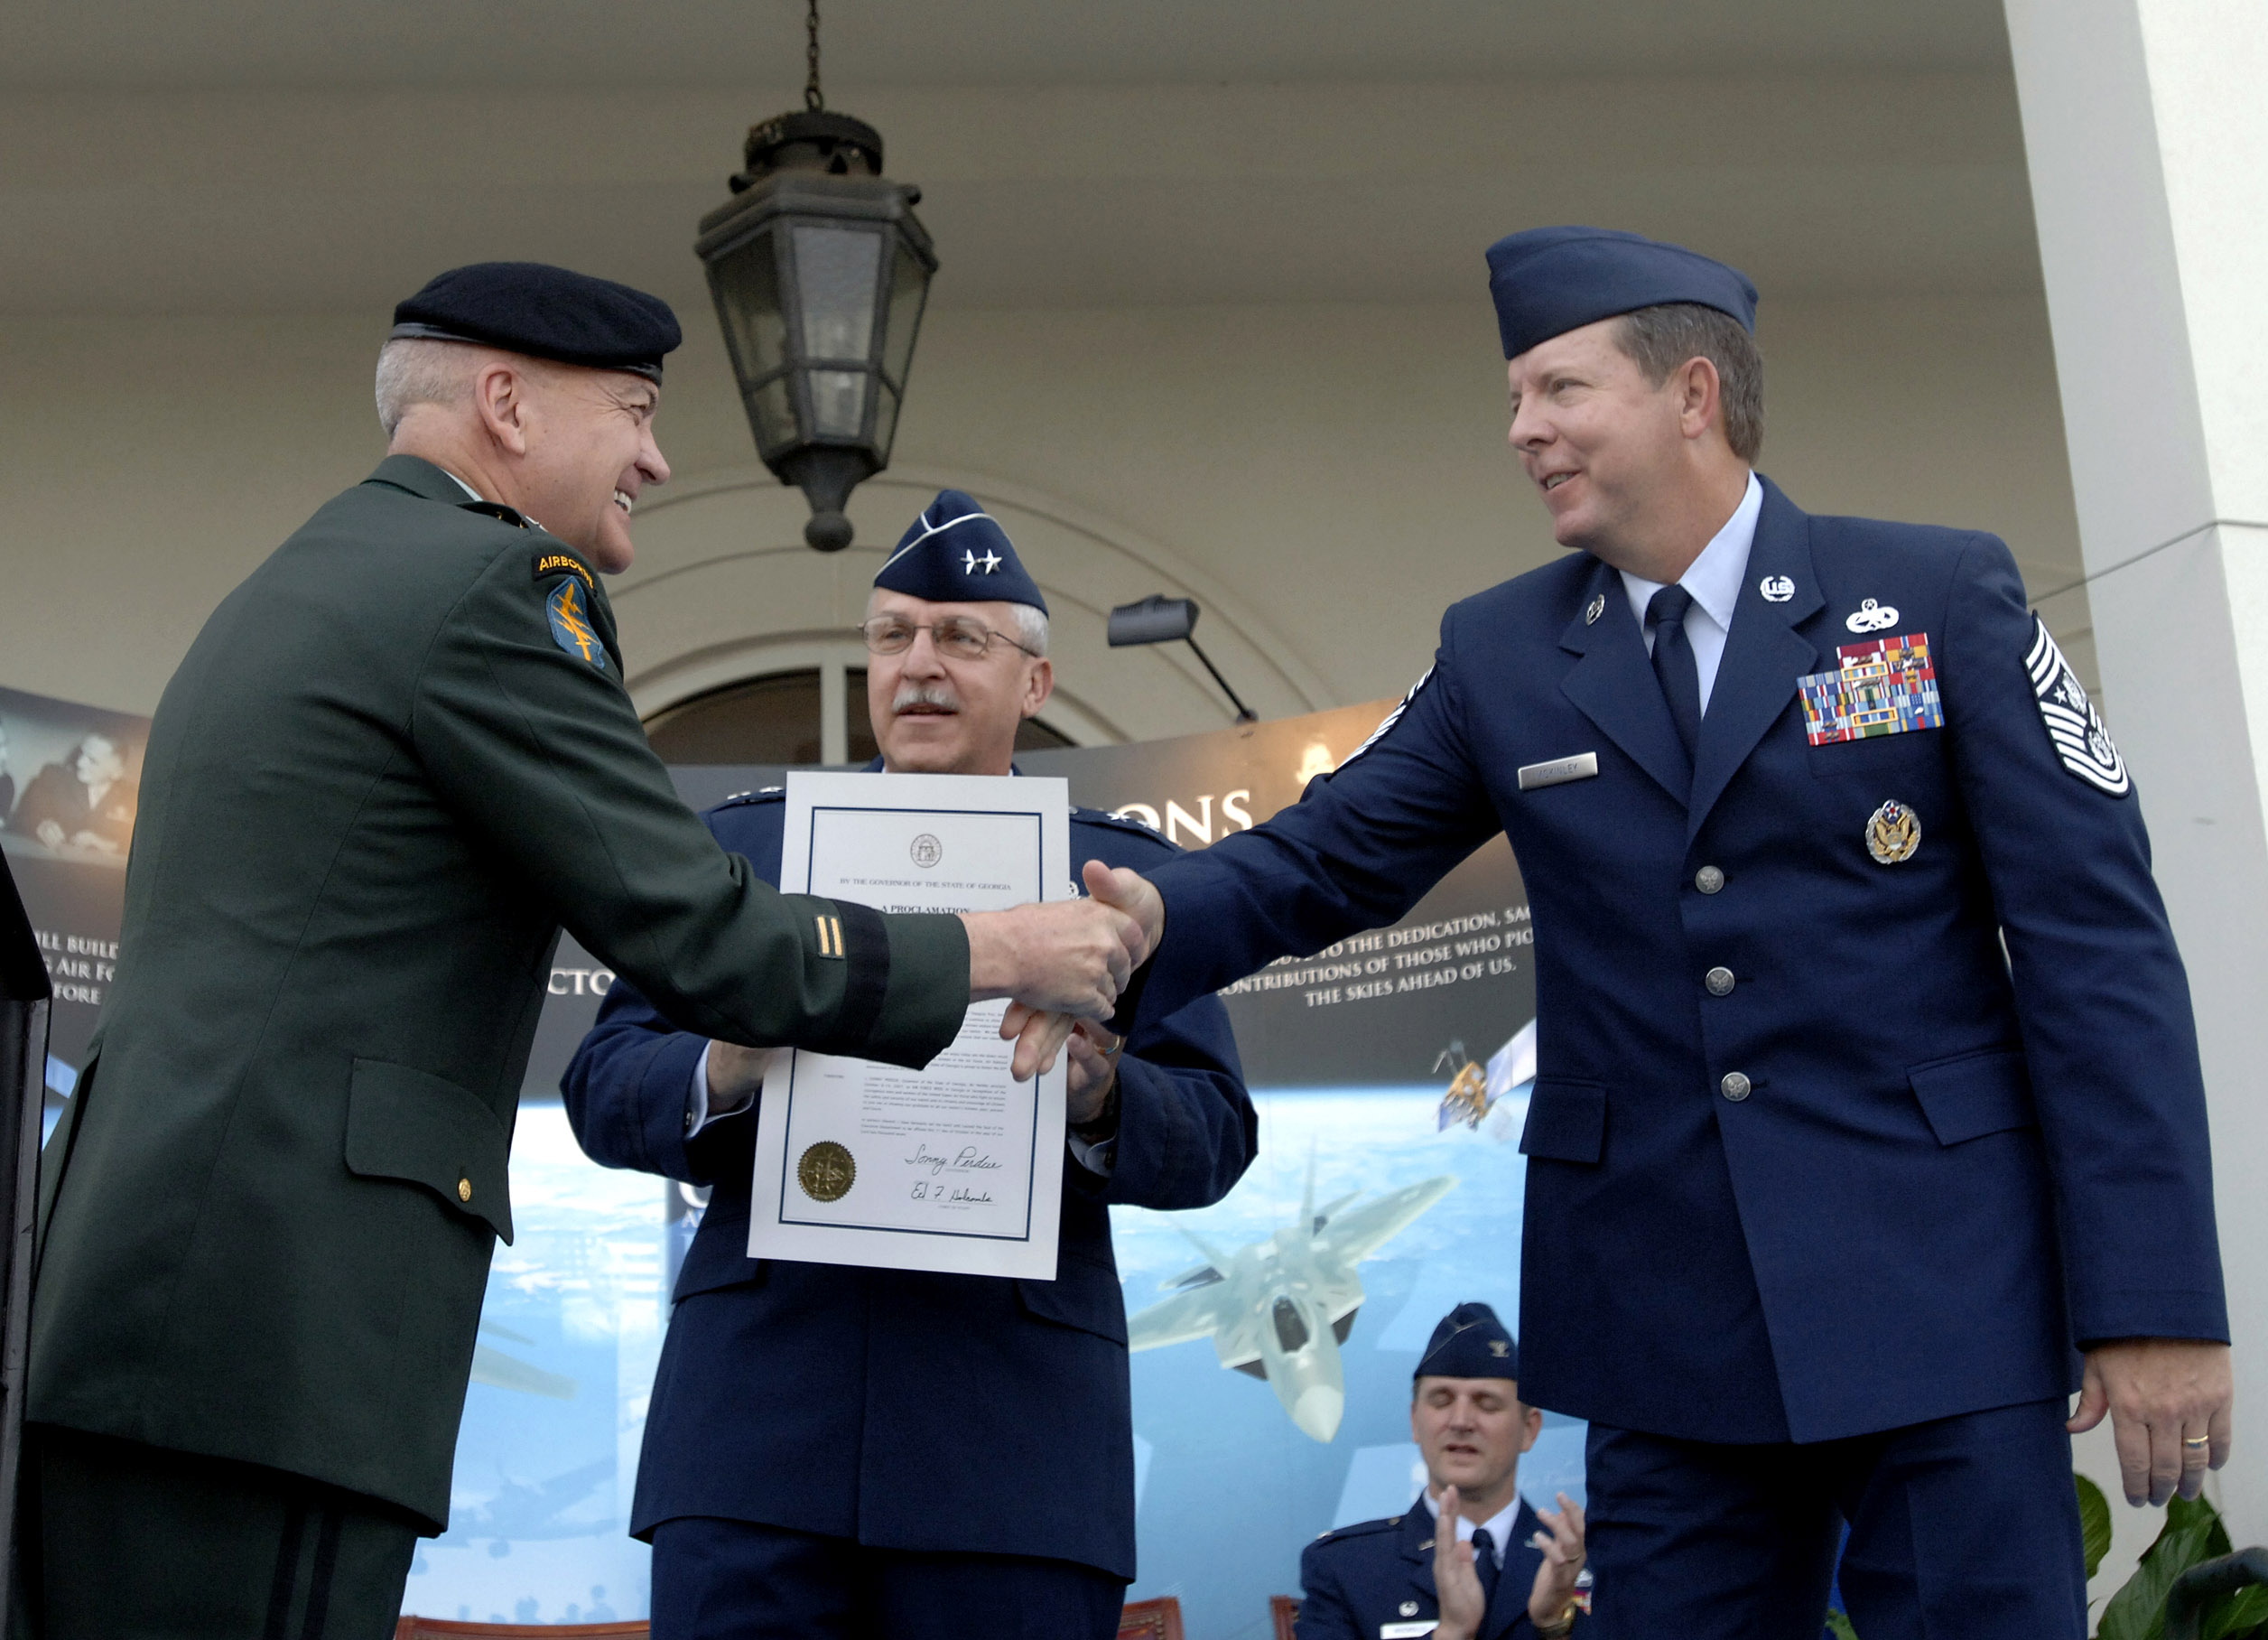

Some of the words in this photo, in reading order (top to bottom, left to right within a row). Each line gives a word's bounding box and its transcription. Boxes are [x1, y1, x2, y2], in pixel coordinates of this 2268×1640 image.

[869, 879, 911, 887] GOVERNOR
[890, 906, 971, 915] PROCLAMATION
[1347, 934, 1384, 955] THE
[1387, 911, 1501, 947] DEDICATION,
[56, 955, 91, 980] AIR
[1217, 961, 1362, 996] ONTRIBUTIONS
[1364, 956, 1390, 974] OF
[1393, 944, 1453, 969] THOSE
[1455, 934, 1501, 957] WHO
[1305, 987, 1343, 1007] THE
[1345, 978, 1393, 1002] SKIES
[1397, 966, 1458, 992] AHEAD
[1460, 961, 1484, 981] OF
[1489, 955, 1517, 975] US.
